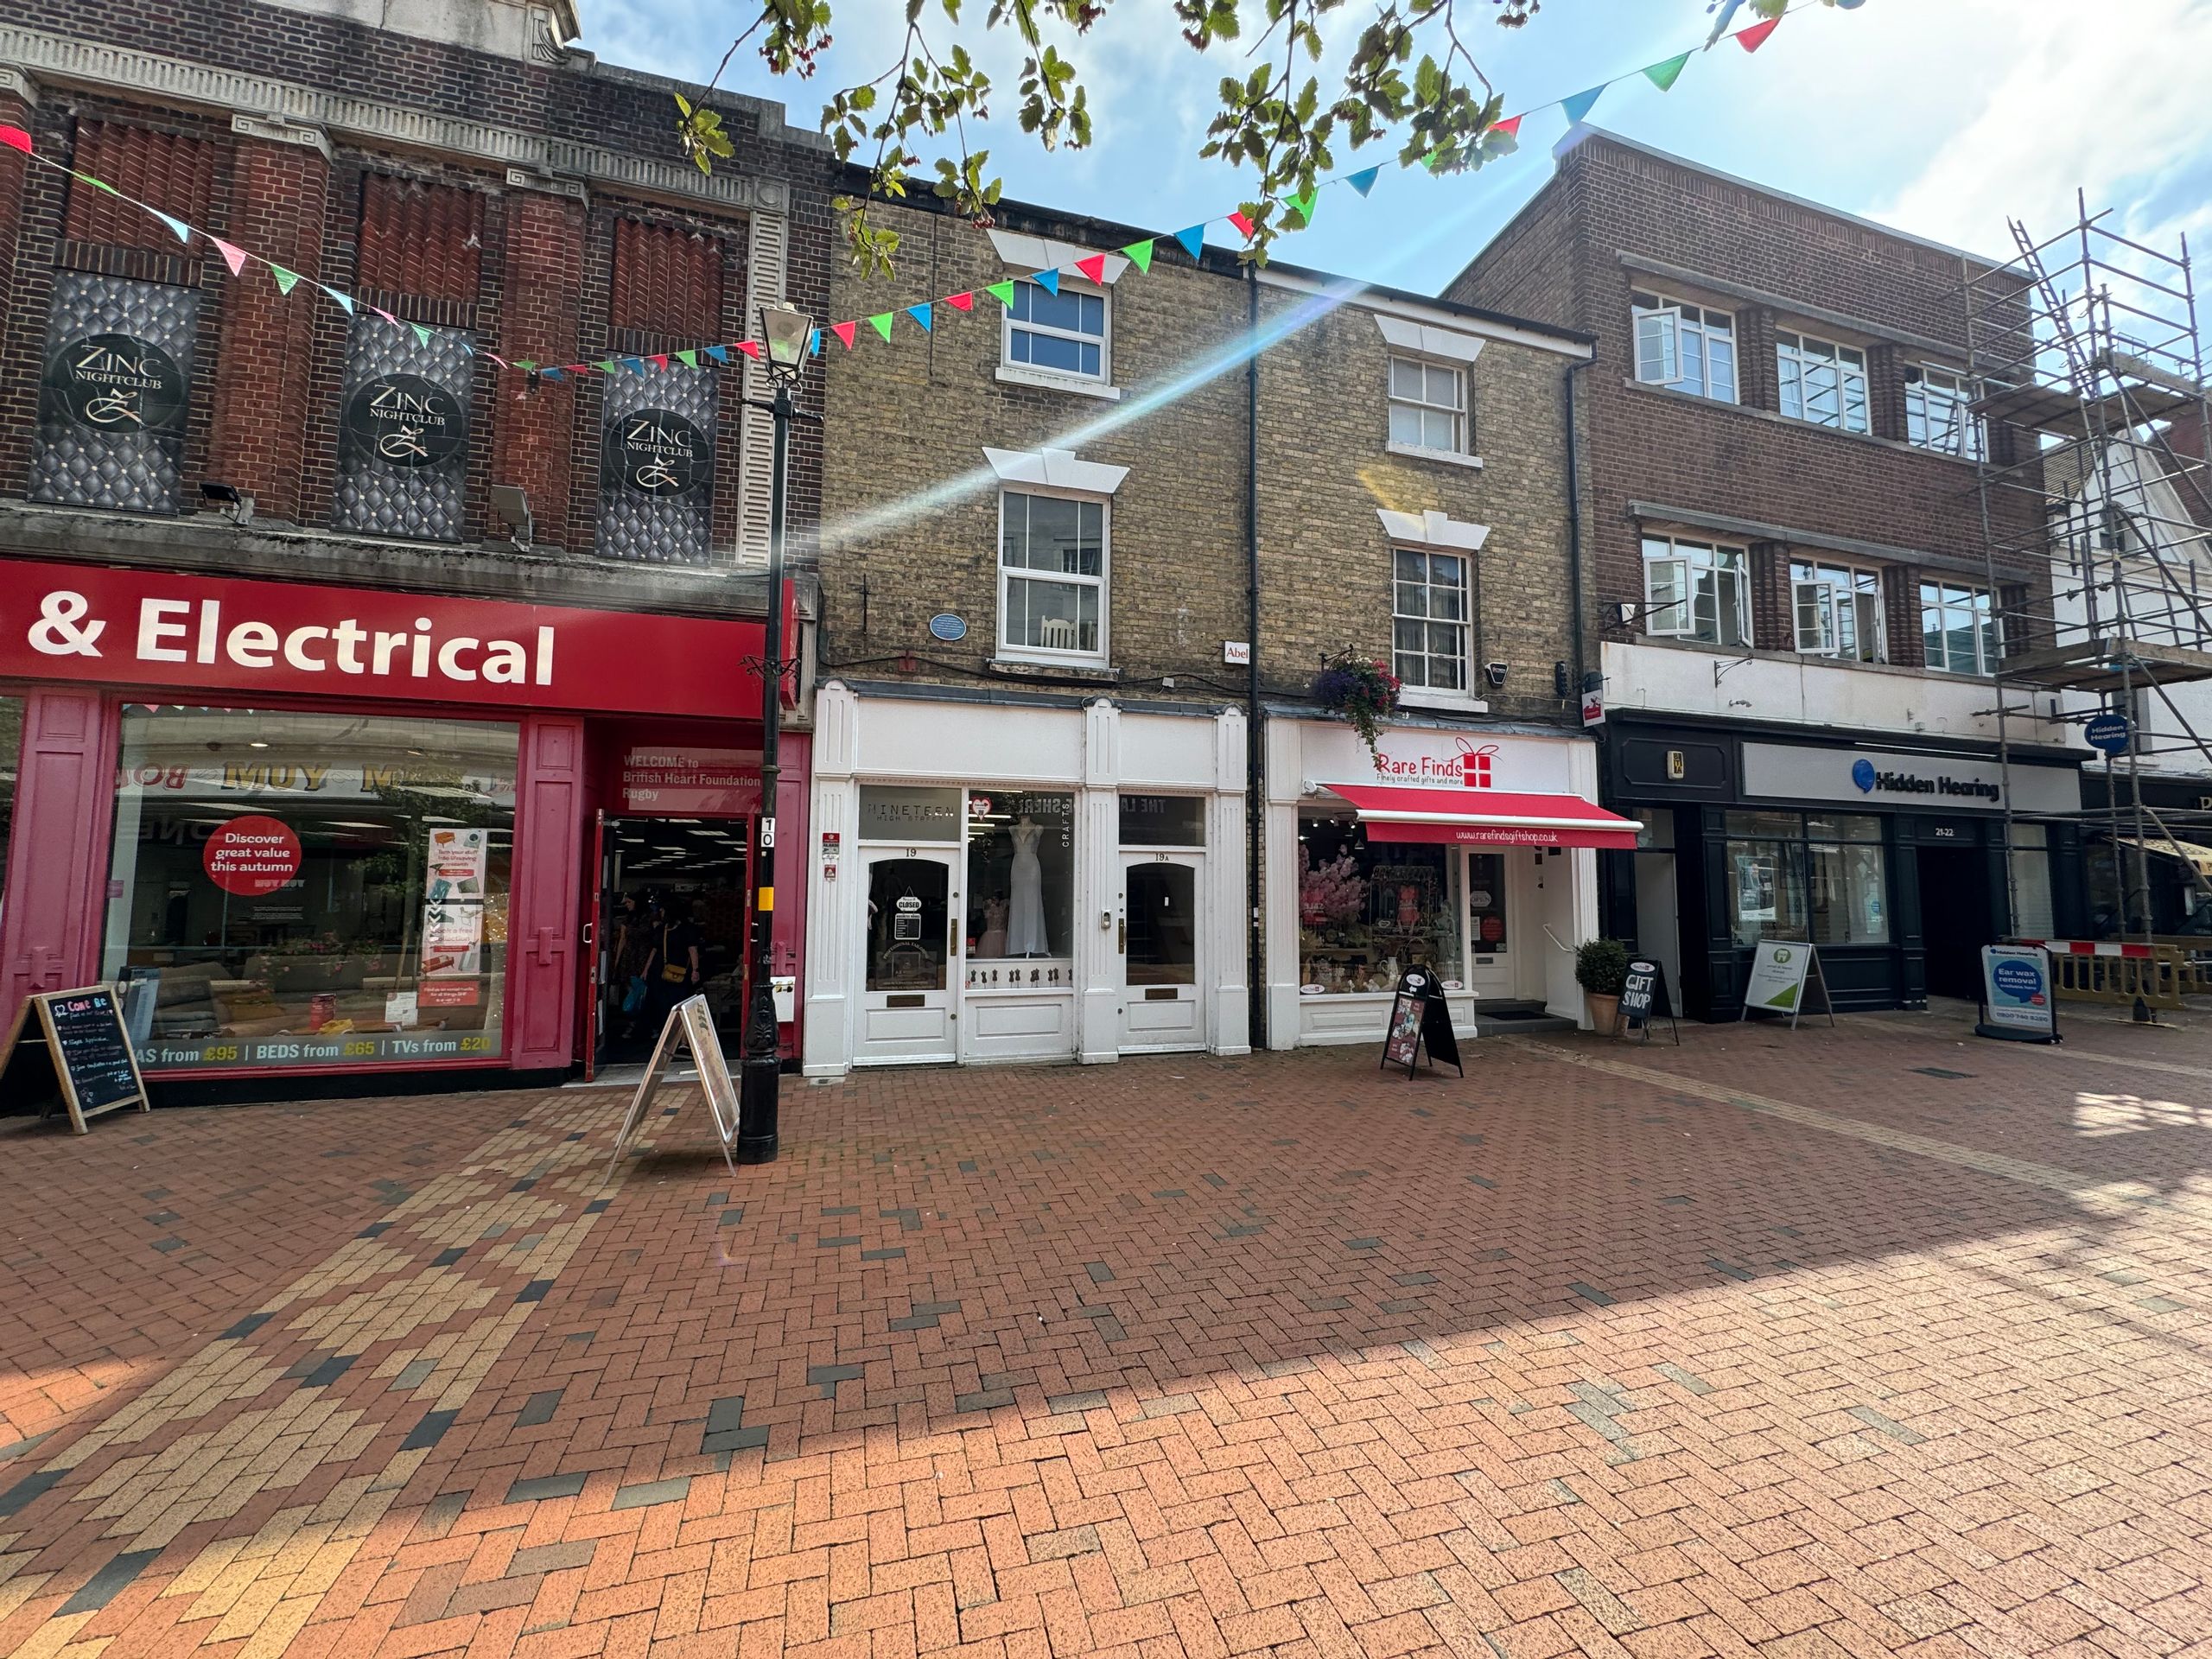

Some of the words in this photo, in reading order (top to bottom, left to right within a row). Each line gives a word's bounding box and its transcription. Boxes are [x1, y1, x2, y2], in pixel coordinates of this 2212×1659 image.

[75, 345, 162, 378] ZINC
[74, 369, 163, 390] NIGHTCLUB
[370, 384, 445, 415] ZINC
[369, 406, 446, 427] NIGHTCLUB
[626, 418, 693, 447] ZINC
[626, 440, 693, 459] NIGHTCLUB
[28, 590, 107, 658] &
[136, 598, 555, 686] Electrical
[1227, 646, 1249, 658] Abel
[2091, 732, 2126, 741] Hearing
[623, 754, 684, 768] WELCOME
[687, 757, 698, 768] to
[1376, 753, 1417, 774] Rare
[1421, 756, 1463, 777] Finds
[623, 771, 661, 784] British
[664, 772, 696, 785] Heart
[699, 773, 760, 787] Foundation
[1376, 773, 1395, 783] Finely
[1396, 774, 1420, 783] crafted
[1421, 775, 1435, 785] gifts
[1436, 776, 1448, 785] and
[1876, 772, 1935, 793] Hidden
[1938, 776, 1999, 802] Hearing
[622, 787, 658, 802] Rugby
[868, 803, 953, 817] NINETEEN
[225, 832, 285, 843] Discover
[1456, 830, 1558, 844] www.rarefindsgiftshop.co.uk
[1936, 827, 1954, 836] 21-22
[214, 847, 252, 861] great
[254, 847, 290, 858] value
[906, 848, 917, 857] 19
[210, 861, 237, 872] this
[239, 861, 293, 872] autumn
[1625, 974, 1654, 992] GIFT
[1999, 976, 2037, 985] removal
[93, 997, 107, 1007] Be
[1622, 991, 1651, 1009] SHOP
[256, 1044, 299, 1059] BEDS
[303, 1043, 339, 1058] from
[342, 1041, 375, 1056] £65
[392, 1039, 419, 1054] TVs
[423, 1039, 456, 1052] from
[460, 1037, 491, 1051] £20
[161, 1047, 200, 1063] from
[202, 1045, 238, 1061] £95
